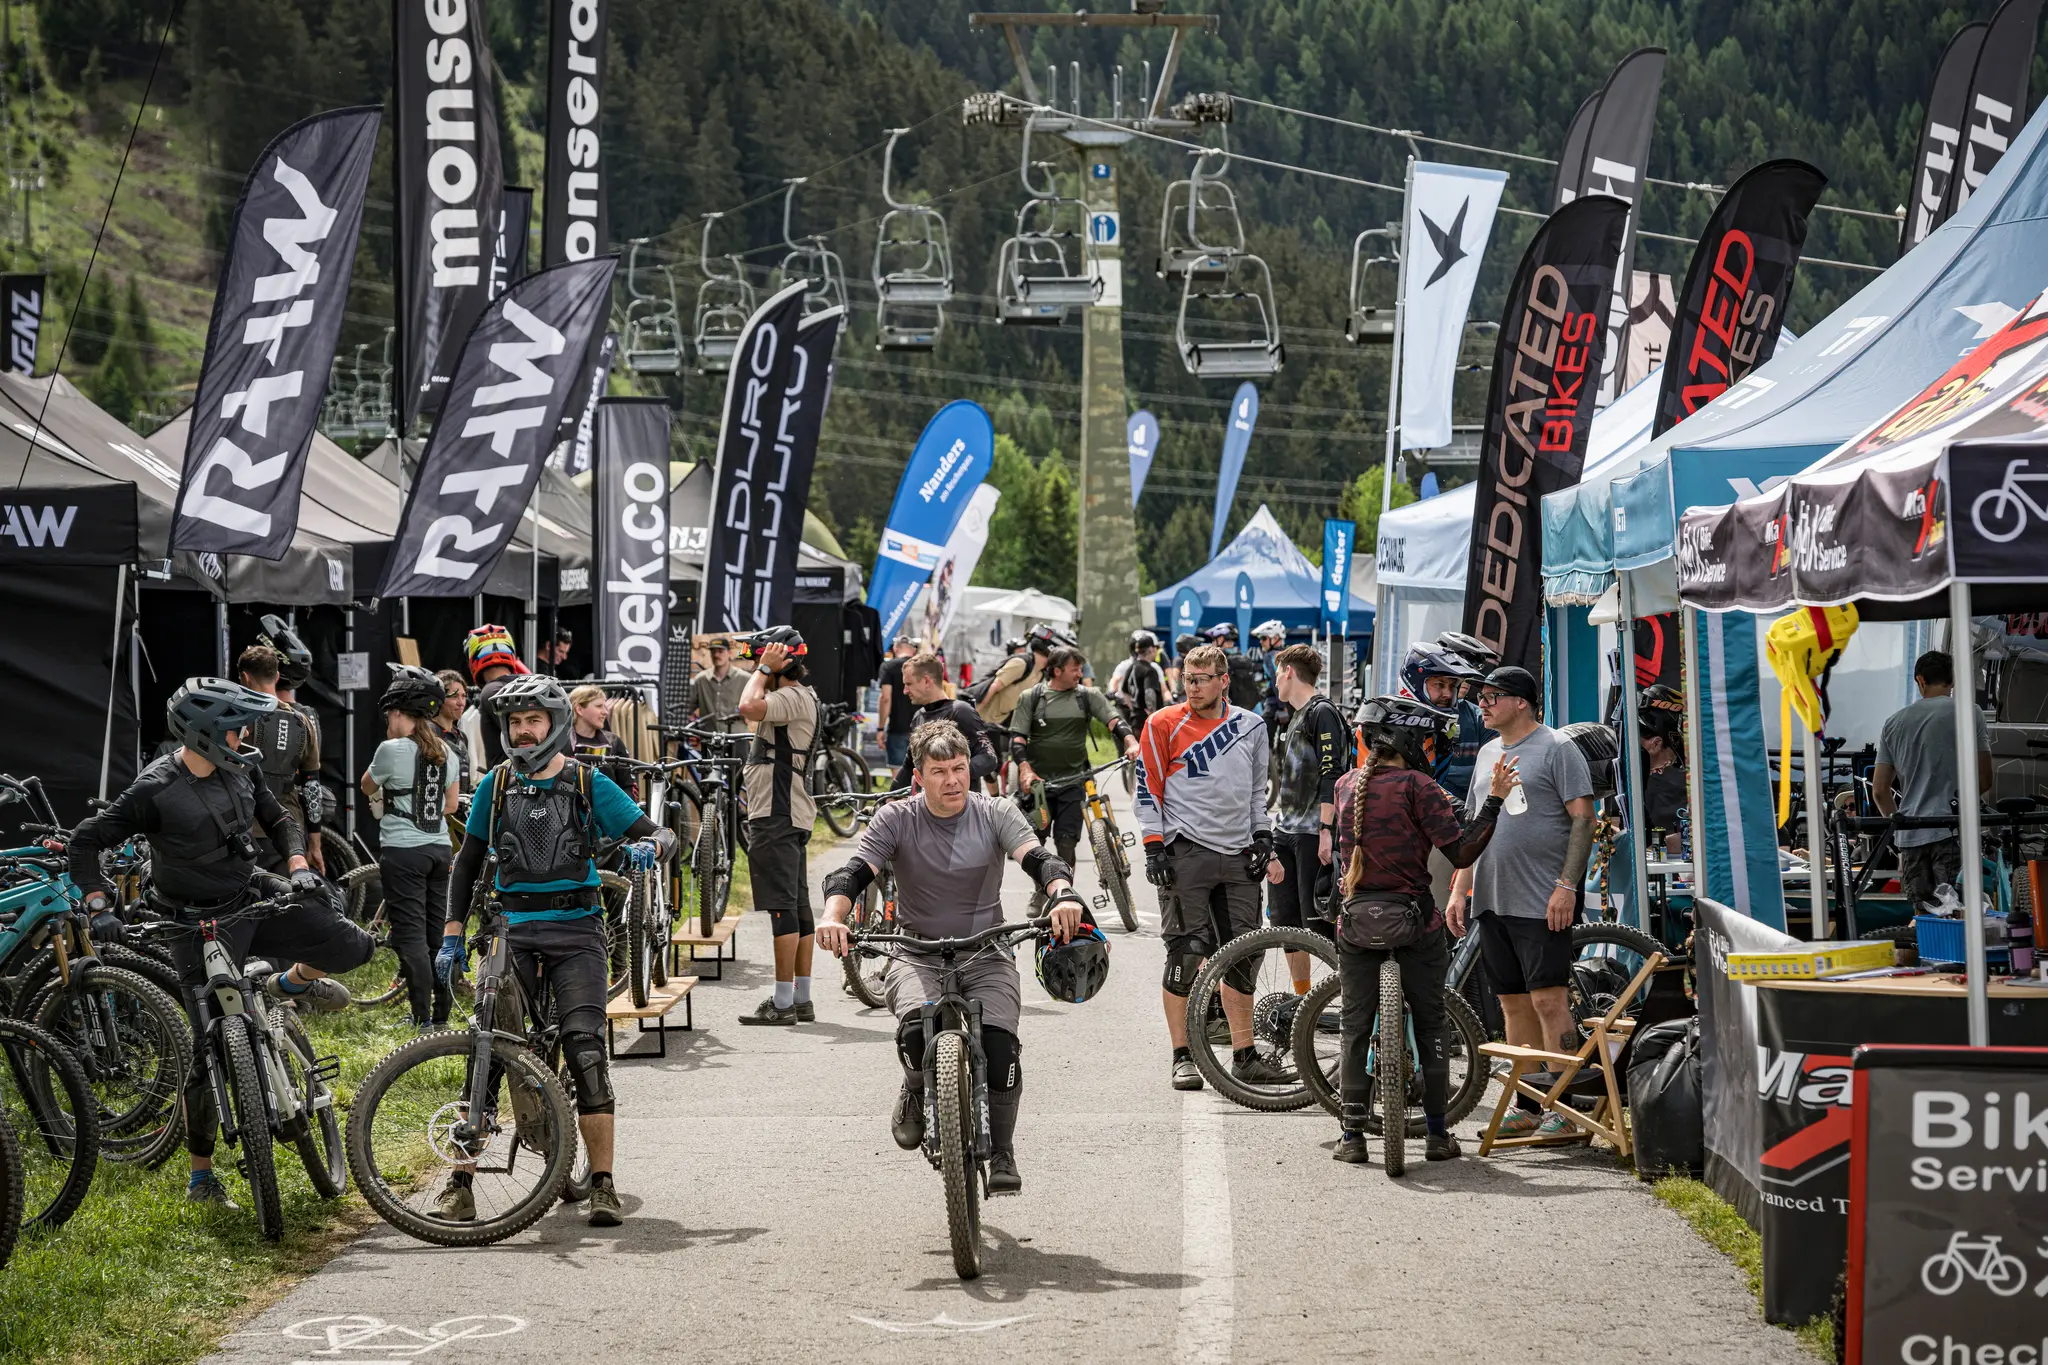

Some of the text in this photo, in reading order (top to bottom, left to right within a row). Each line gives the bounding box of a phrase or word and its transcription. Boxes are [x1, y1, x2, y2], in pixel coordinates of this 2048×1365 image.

[1540, 312, 1595, 452] BIKES
[723, 323, 778, 632] ELDURO
[919, 438, 966, 503] Nauders
[1475, 265, 1569, 666] DEDICATED
[1332, 530, 1348, 585] deuter
[1818, 540, 1847, 571] Service
[1839, 833, 1851, 873] FEEDBACK
[518, 1054, 546, 1080] Continental
[1434, 1038, 1443, 1059] FOX
